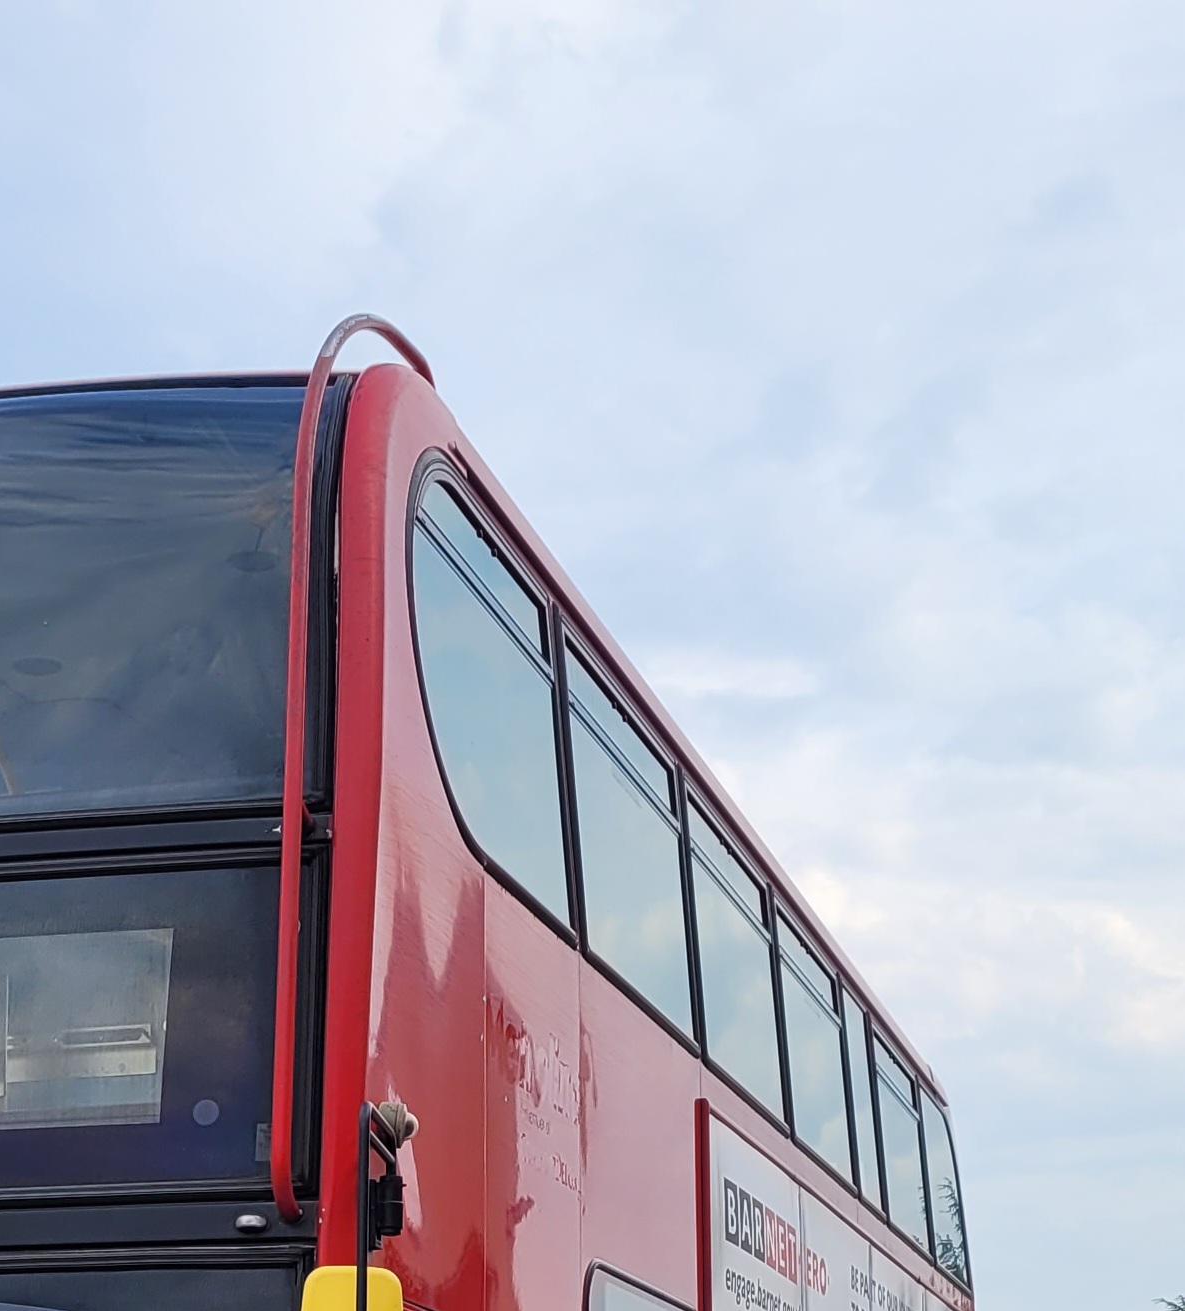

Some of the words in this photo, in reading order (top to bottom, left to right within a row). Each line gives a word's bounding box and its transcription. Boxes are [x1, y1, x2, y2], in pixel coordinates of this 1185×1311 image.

[725, 1180, 797, 1283] BARNET
[850, 1265, 859, 1294] BE
[860, 1273, 877, 1303] PAT
[877, 1283, 886, 1307] OF
